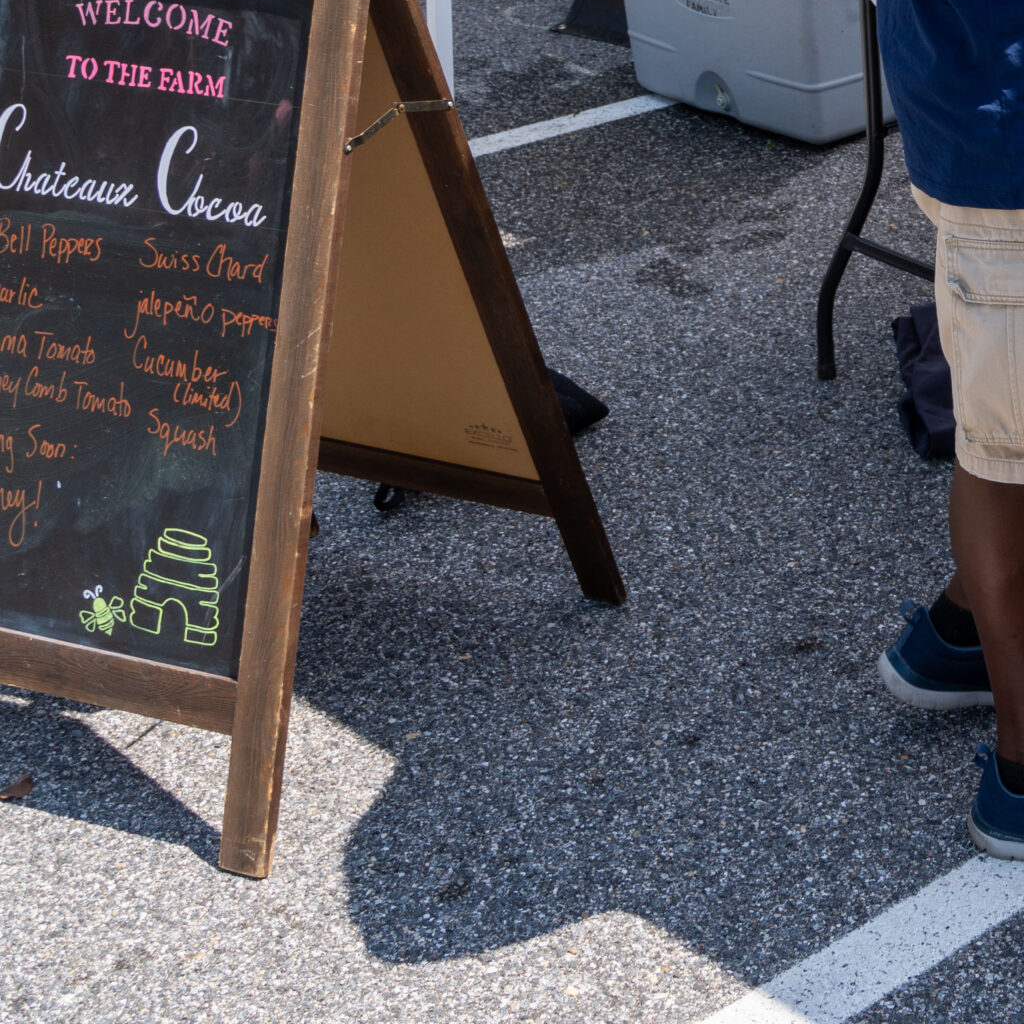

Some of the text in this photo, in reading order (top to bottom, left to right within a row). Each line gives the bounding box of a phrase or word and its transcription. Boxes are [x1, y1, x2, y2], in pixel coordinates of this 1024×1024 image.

[75, 0, 233, 47] WELCOME
[65, 54, 227, 99] TO THE FARM
[157, 126, 267, 227] Cocoa
[0, 217, 32, 254] Bell
[139, 237, 270, 284] Swiss Chard
[0, 277, 43, 309] arlic
[34, 330, 96, 365] Tomato
[133, 335, 228, 383] Cucumber
[73, 381, 132, 417] Tomato
[147, 408, 217, 456] Squash
